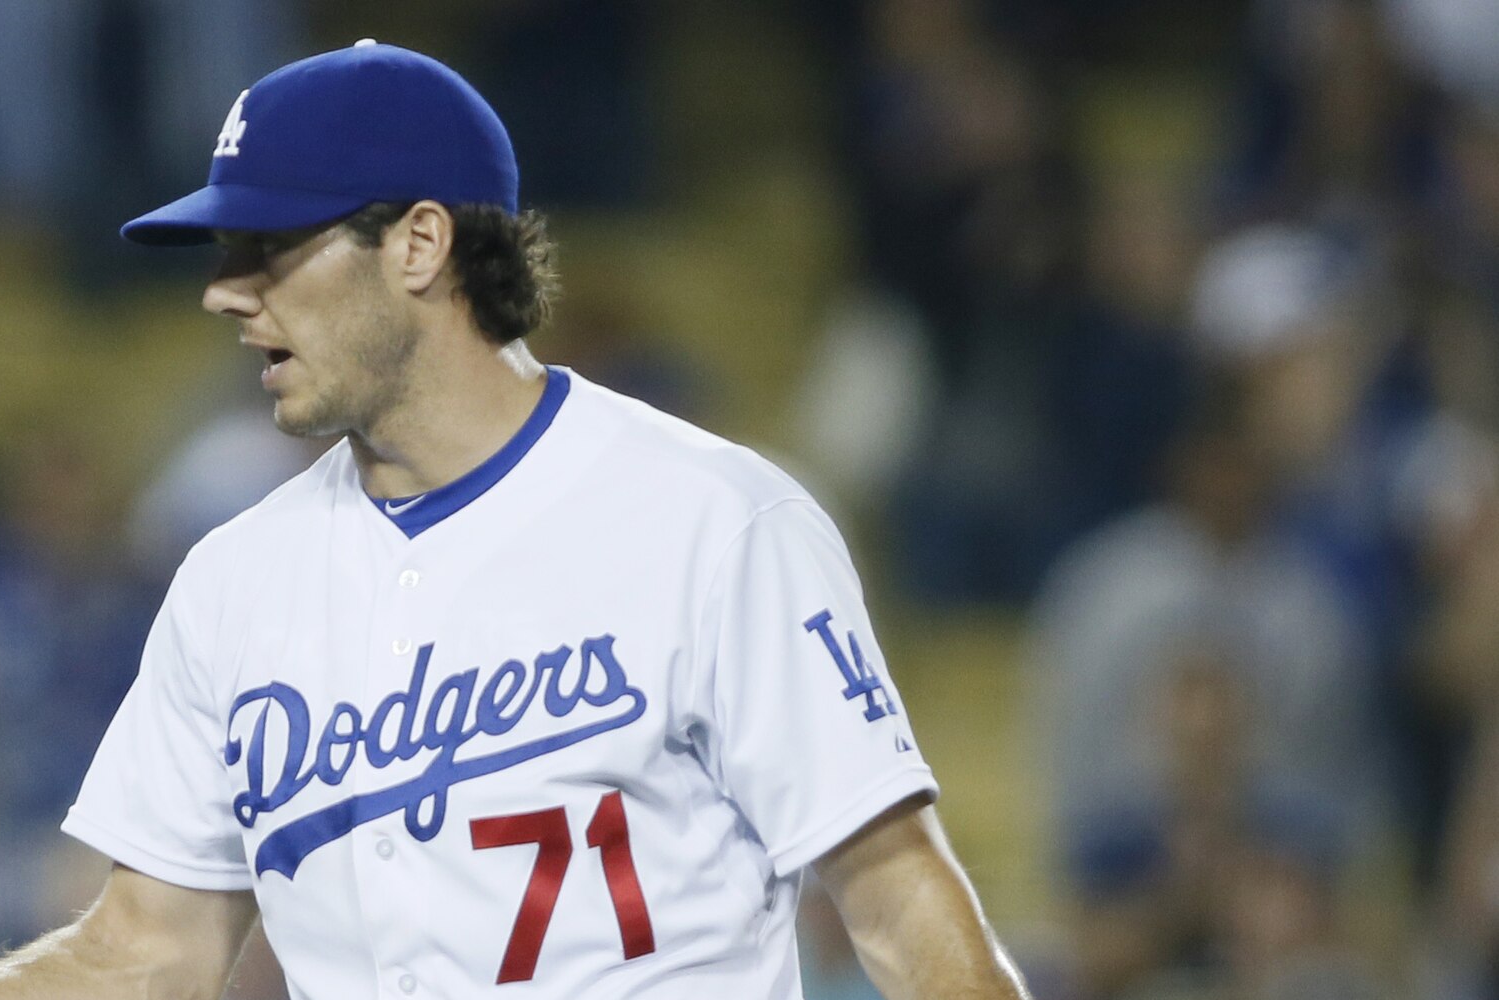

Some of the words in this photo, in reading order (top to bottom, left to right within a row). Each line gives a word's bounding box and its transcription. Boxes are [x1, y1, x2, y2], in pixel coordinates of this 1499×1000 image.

[224, 633, 647, 881] Dodgers
[803, 608, 898, 723] LA
[468, 789, 655, 985] 71
